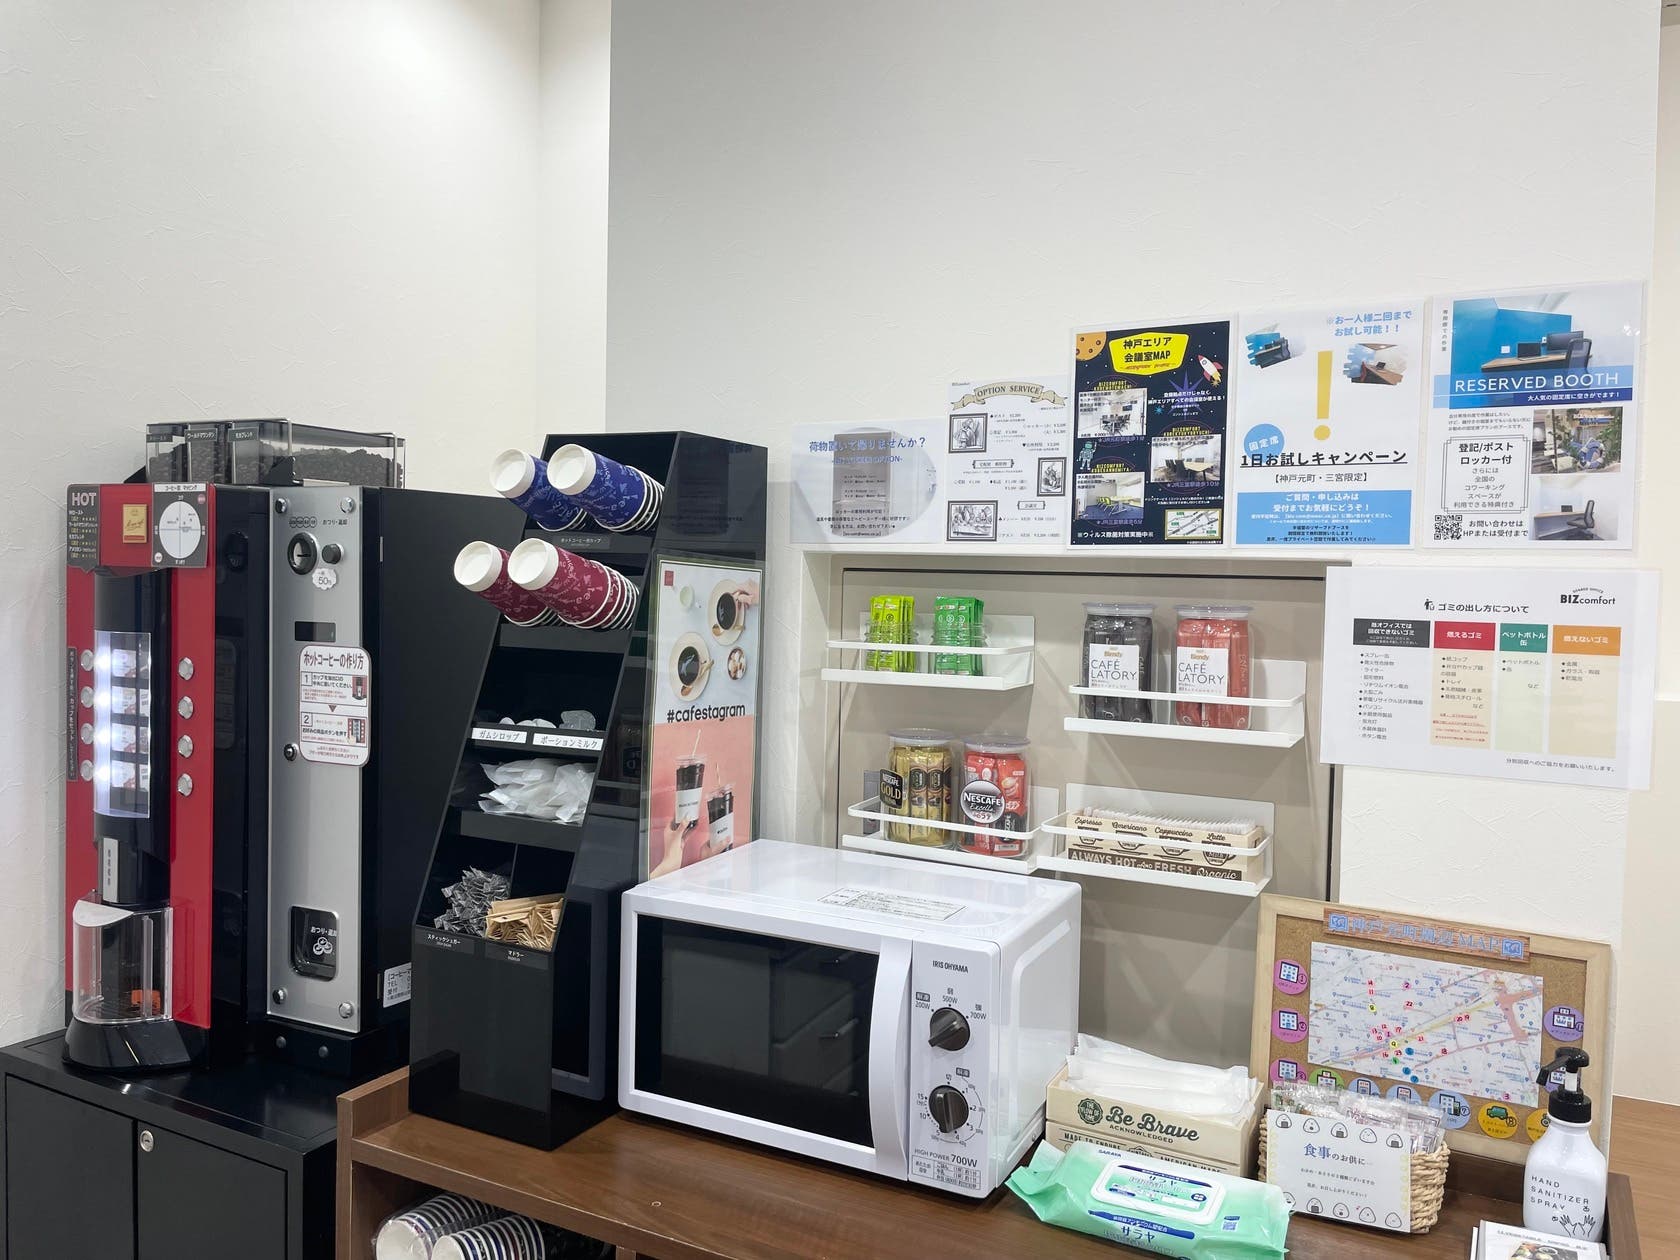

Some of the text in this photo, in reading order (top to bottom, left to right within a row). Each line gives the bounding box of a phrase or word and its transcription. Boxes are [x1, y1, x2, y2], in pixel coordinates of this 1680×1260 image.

[1334, 324, 1400, 337] お試し可能！！
[1123, 337, 1172, 350] 神戸エリア
[1125, 350, 1170, 363] 会議室MAP
[1455, 373, 1619, 393] RESERVED BOOTH
[977, 386, 1040, 397] OPTION SERVICE
[1459, 442, 1513, 453] 登記/ポスト
[1241, 450, 1407, 467] 1日お試しキャンペーン
[1461, 455, 1512, 464] ロッカー付
[1275, 472, 1368, 483] 【神戸元町・三宮限定】
[1474, 475, 1495, 483] 全国の
[1464, 484, 1505, 492] コワーキング
[72, 492, 96, 506] HOT
[1286, 493, 1359, 502] ご質問・申し込みは
[1467, 492, 1502, 500] スペースが
[1273, 504, 1369, 512] 受付までお気軽にどうぞ！
[1453, 501, 1514, 509] 利用できる特典付き
[1469, 520, 1523, 528] お問い合わせは
[1463, 529, 1528, 538] HPまたは受付まで
[1560, 594, 1616, 605] BIZcomfort
[1438, 602, 1530, 615] ゴミの出し方について
[1447, 631, 1482, 639] 燃えるゴミ
[1502, 631, 1546, 639] ペットボトル
[304, 651, 364, 670] ホットコーヒーの作り方
[1191, 653, 1210, 661] Blendy
[1091, 659, 1120, 670] CAFÉ
[1179, 662, 1206, 673] CAFÉ
[305, 675, 308, 683] 1
[1178, 673, 1224, 684] LATORY
[667, 703, 746, 723] #cafestagram
[304, 715, 309, 724] 2
[479, 730, 520, 742] ガムシロップ
[881, 782, 901, 800] GOLD
[1075, 817, 1103, 826] Espresso
[1112, 822, 1147, 832] Americano
[1155, 827, 1193, 838] Cappuccino
[1206, 833, 1226, 841] Latte
[1072, 852, 1112, 864] ALWAYS
[1116, 857, 1137, 868] HOT
[1154, 864, 1192, 875] FRESH
[933, 960, 968, 973] IRIS OHYAMA
[1105, 1106, 1200, 1141] Be Brave
[1064, 1133, 1082, 1142] MADE
[1109, 1124, 1173, 1144] ACKNOWLEDGED
[930, 1152, 949, 1160] POWER
[951, 1154, 977, 1167] 700W
[1149, 1175, 1177, 1186] サラヤ
[1532, 1176, 1560, 1188] HAND
[1531, 1186, 1589, 1204] SANITIZER
[1530, 1196, 1566, 1210] SPRAY
[1121, 1224, 1155, 1244] サラヤ
